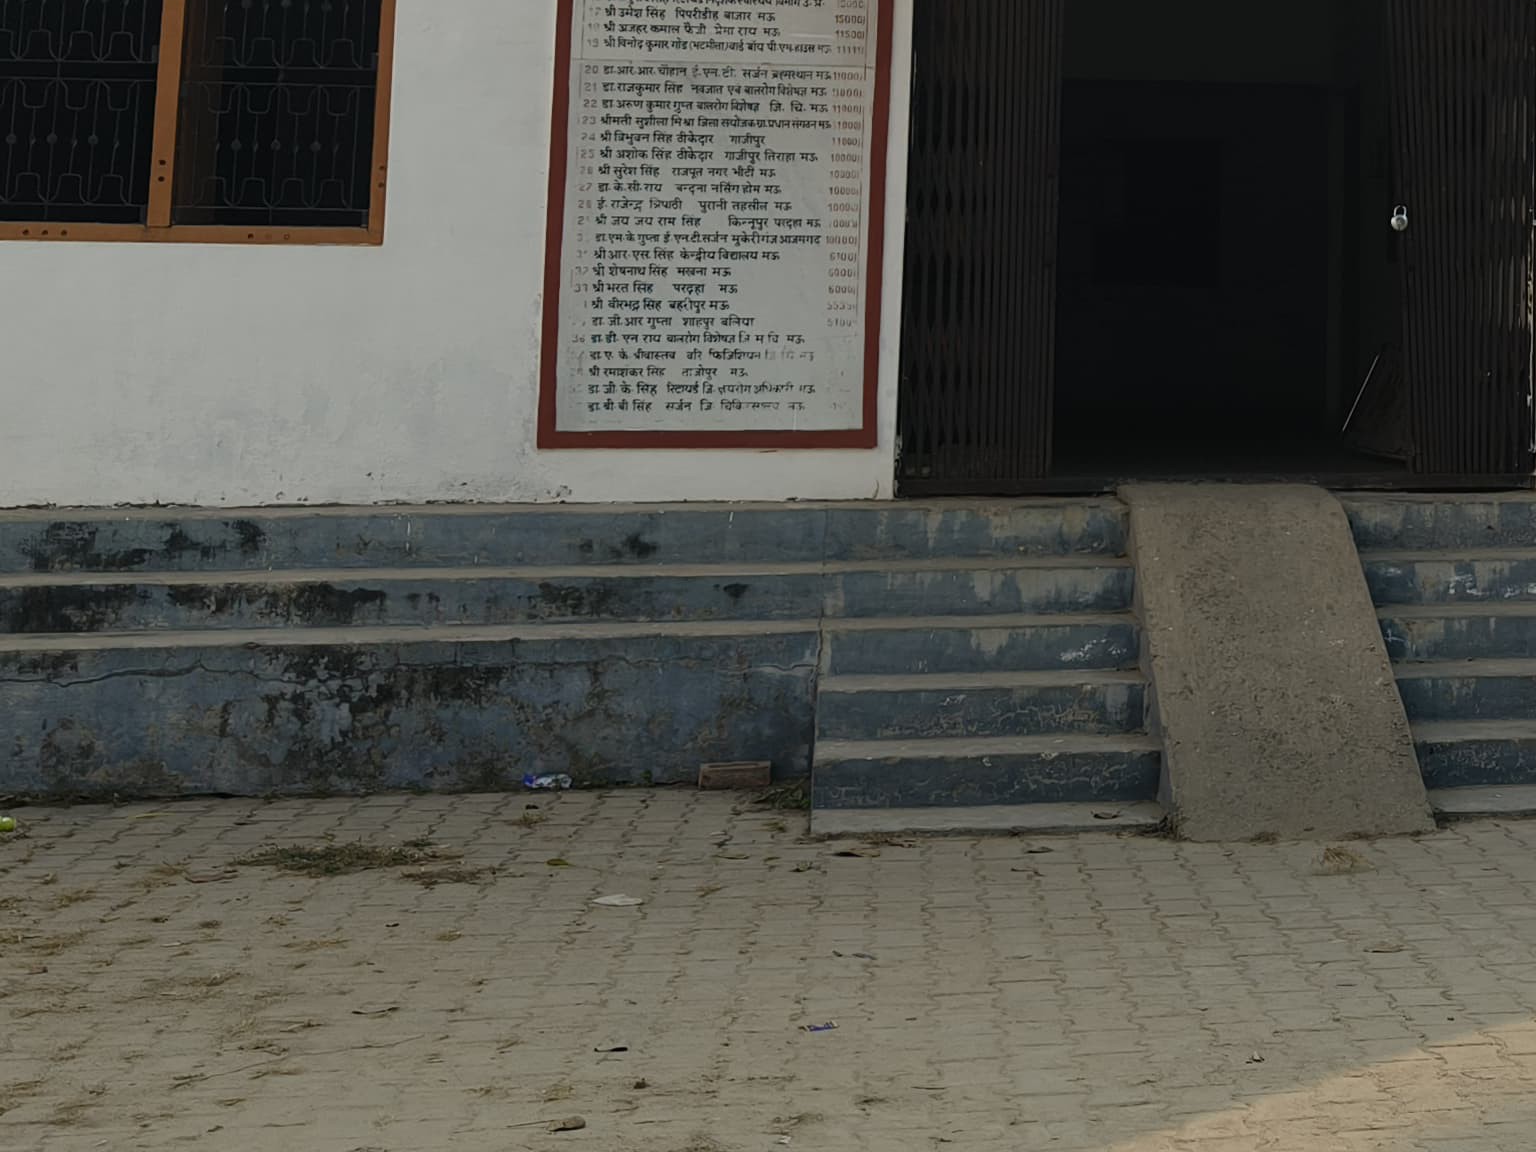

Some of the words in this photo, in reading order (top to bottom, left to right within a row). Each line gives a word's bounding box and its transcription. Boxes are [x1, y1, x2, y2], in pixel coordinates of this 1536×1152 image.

[605, 4, 616, 17] श्री
[618, 5, 643, 18] उमेश
[646, 6, 666, 20] सिंह
[675, 6, 719, 21] पिपरीडीह
[724, 11, 751, 21] बाजार
[758, 12, 776, 22] मऊ
[664, 80, 683, 94] सिंह
[584, 99, 597, 108] 22
[646, 100, 671, 113] कुमार
[809, 104, 828, 113] मऊ
[600, 130, 612, 143] श्री
[653, 130, 673, 144] सिंह
[676, 130, 714, 147] ठीकेदार
[729, 132, 766, 148] गाजीपुर
[600, 146, 612, 159] श्री
[616, 146, 648, 160] अशोक
[651, 146, 672, 160] सिंह
[676, 146, 713, 162] ठीकेदार
[724, 148, 760, 164] गाजीपुर
[764, 148, 796, 162] तिराहा
[800, 153, 818, 162] मऊ
[610, 196, 644, 212] राजेन्द्र
[649, 197, 683, 210] त्रिपाठी
[698, 199, 728, 213] पुरानी
[731, 199, 768, 211] तहसील
[774, 202, 792, 211] मऊ
[595, 213, 607, 225] श्री
[611, 216, 630, 225] जय
[634, 217, 653, 225] जय
[657, 216, 676, 226] राम
[681, 214, 701, 228] सिंह
[774, 218, 802, 230] परदहा
[806, 219, 821, 228] मऊ
[680, 247, 716, 262] केन्द्रीय
[718, 247, 758, 260] विद्यालय
[762, 251, 780, 260] मऊ
[592, 280, 604, 293] श्री
[607, 283, 629, 293] भरत
[633, 280, 654, 294] सिंह
[672, 283, 705, 295] परदहा
[719, 284, 738, 295] मऊ
